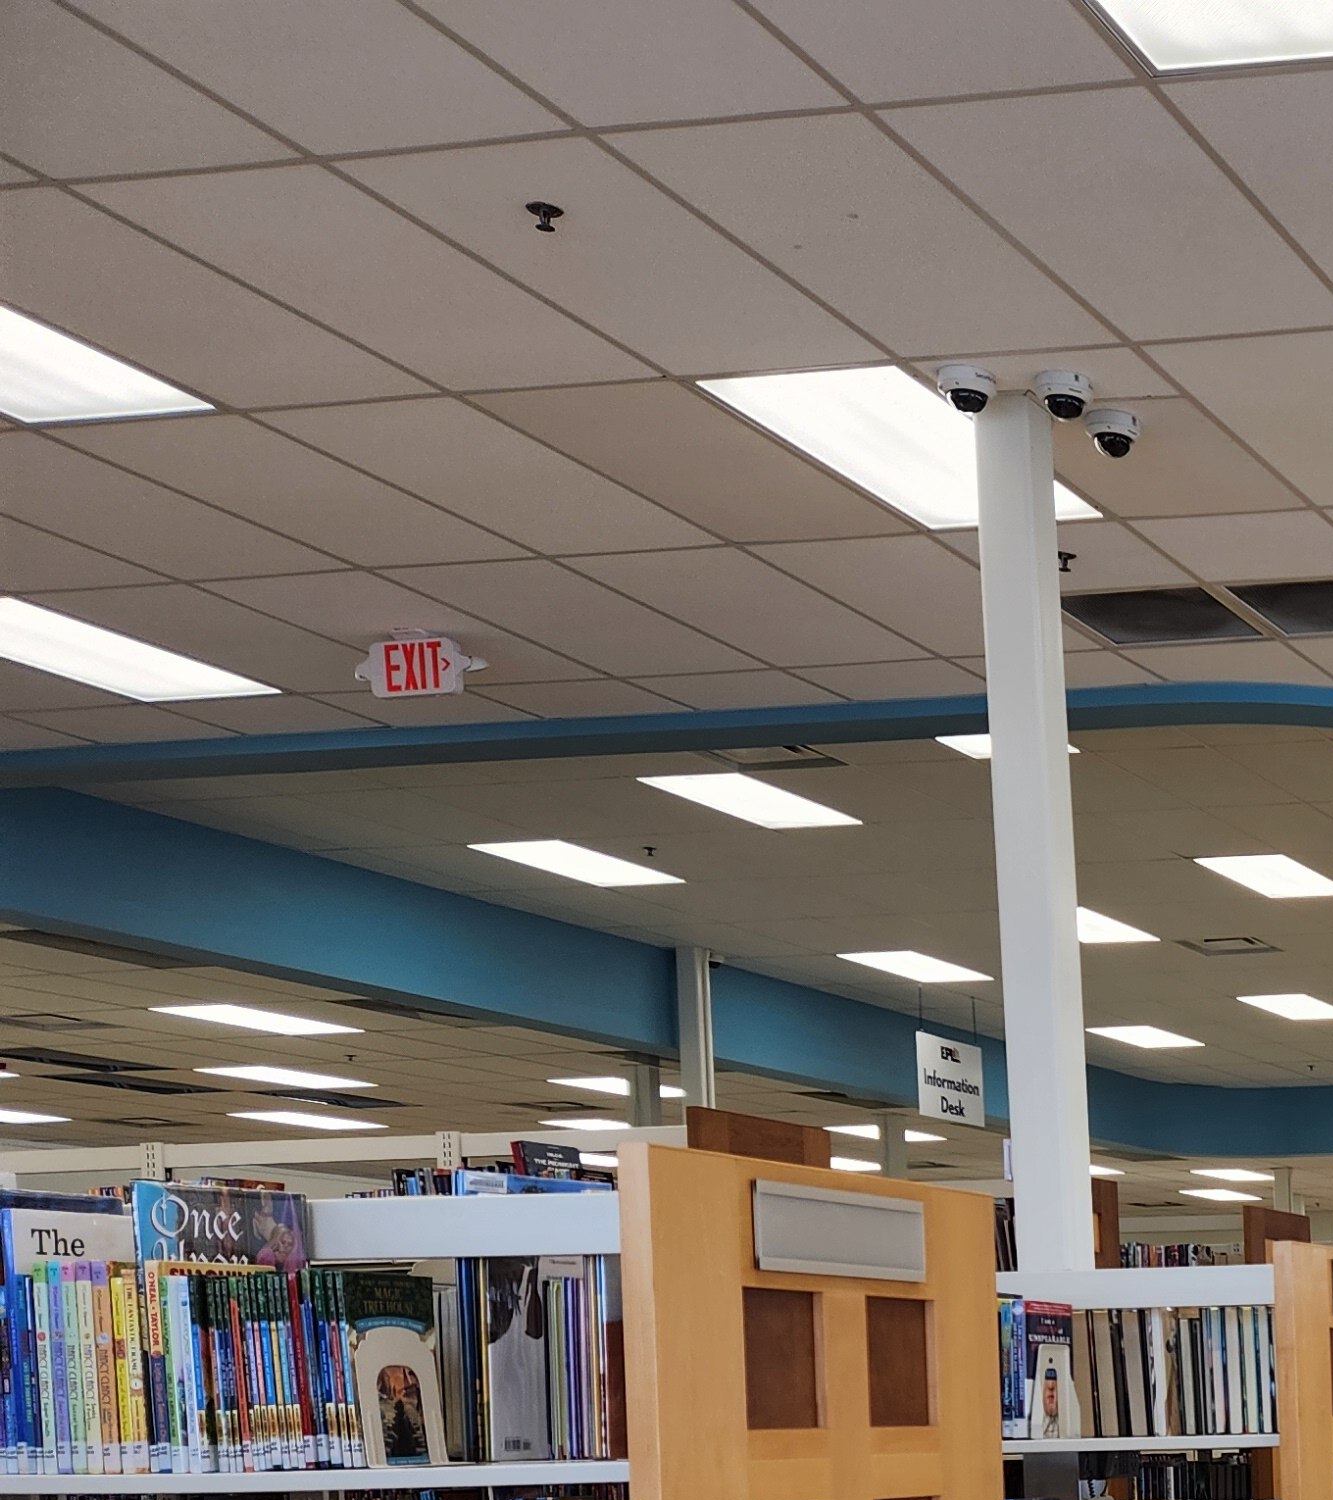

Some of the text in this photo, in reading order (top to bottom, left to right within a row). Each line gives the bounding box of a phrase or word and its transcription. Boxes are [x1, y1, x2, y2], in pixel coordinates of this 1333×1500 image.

[384, 641, 442, 692] EXIT
[924, 1068, 980, 1096] Information
[941, 1096, 966, 1117] Desk
[151, 1193, 244, 1242] Once
[30, 1228, 86, 1258] The
[127, 1304, 136, 1342] FANTASTIC
[148, 1272, 160, 1346] O'NEAL TAYLOR
